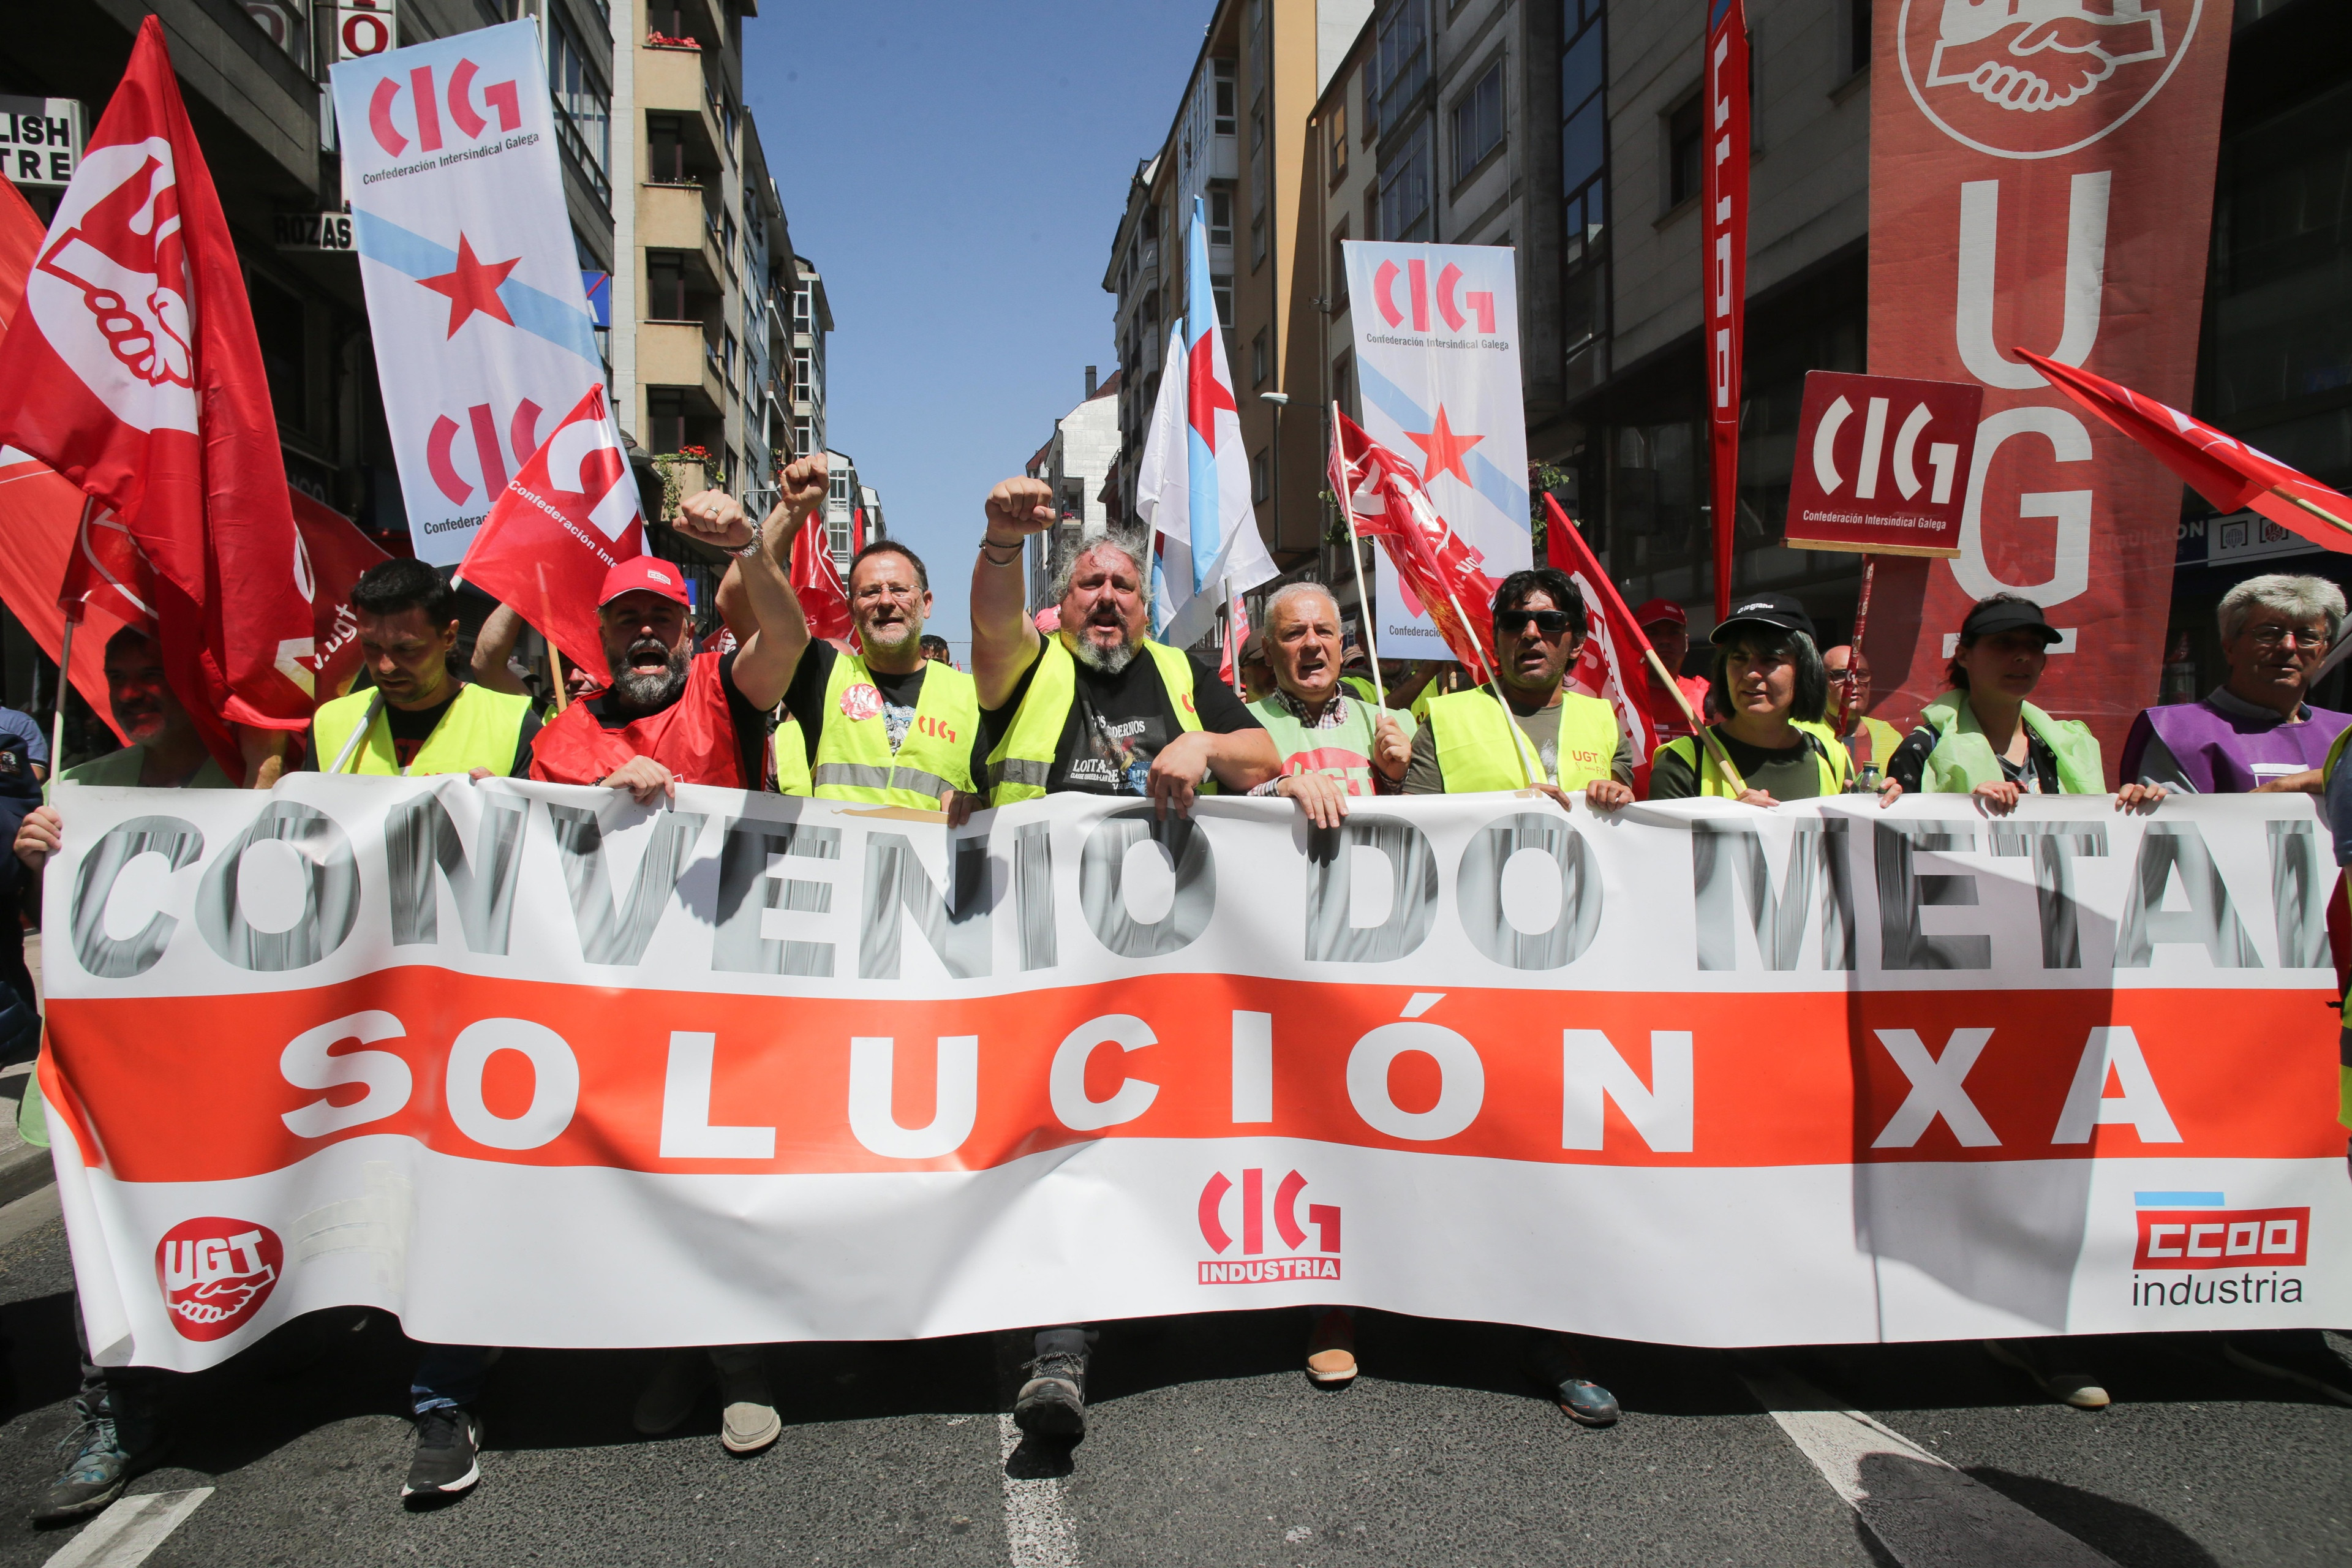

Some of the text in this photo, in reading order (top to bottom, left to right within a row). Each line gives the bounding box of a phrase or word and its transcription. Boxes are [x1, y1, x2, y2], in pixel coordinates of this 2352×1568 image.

[369, 58, 522, 159] CIG
[363, 132, 540, 185] Confederación Intersindical Galega
[1373, 258, 1496, 334] CIG
[1366, 333, 1509, 351] Confederación Intersindical Galega
[1813, 394, 1959, 505] CIG
[508, 480, 596, 550] Confederación
[1803, 510, 1947, 531] Confederación Intersindical Galega
[918, 715, 956, 744] CIG
[1107, 720, 1146, 738] DERNOS
[1572, 750, 1598, 764] UGT
[70, 790, 2335, 980] CONVENIO DO METAL
[279, 992, 2184, 1159] SOLUCIÓN XA
[1198, 1167, 1341, 1256] CIG
[165, 1229, 263, 1291] UGT
[2147, 1219, 2297, 1258] CCOO
[1201, 1259, 1338, 1283] INDUSTRIA
[2132, 1270, 2302, 1306] industria
